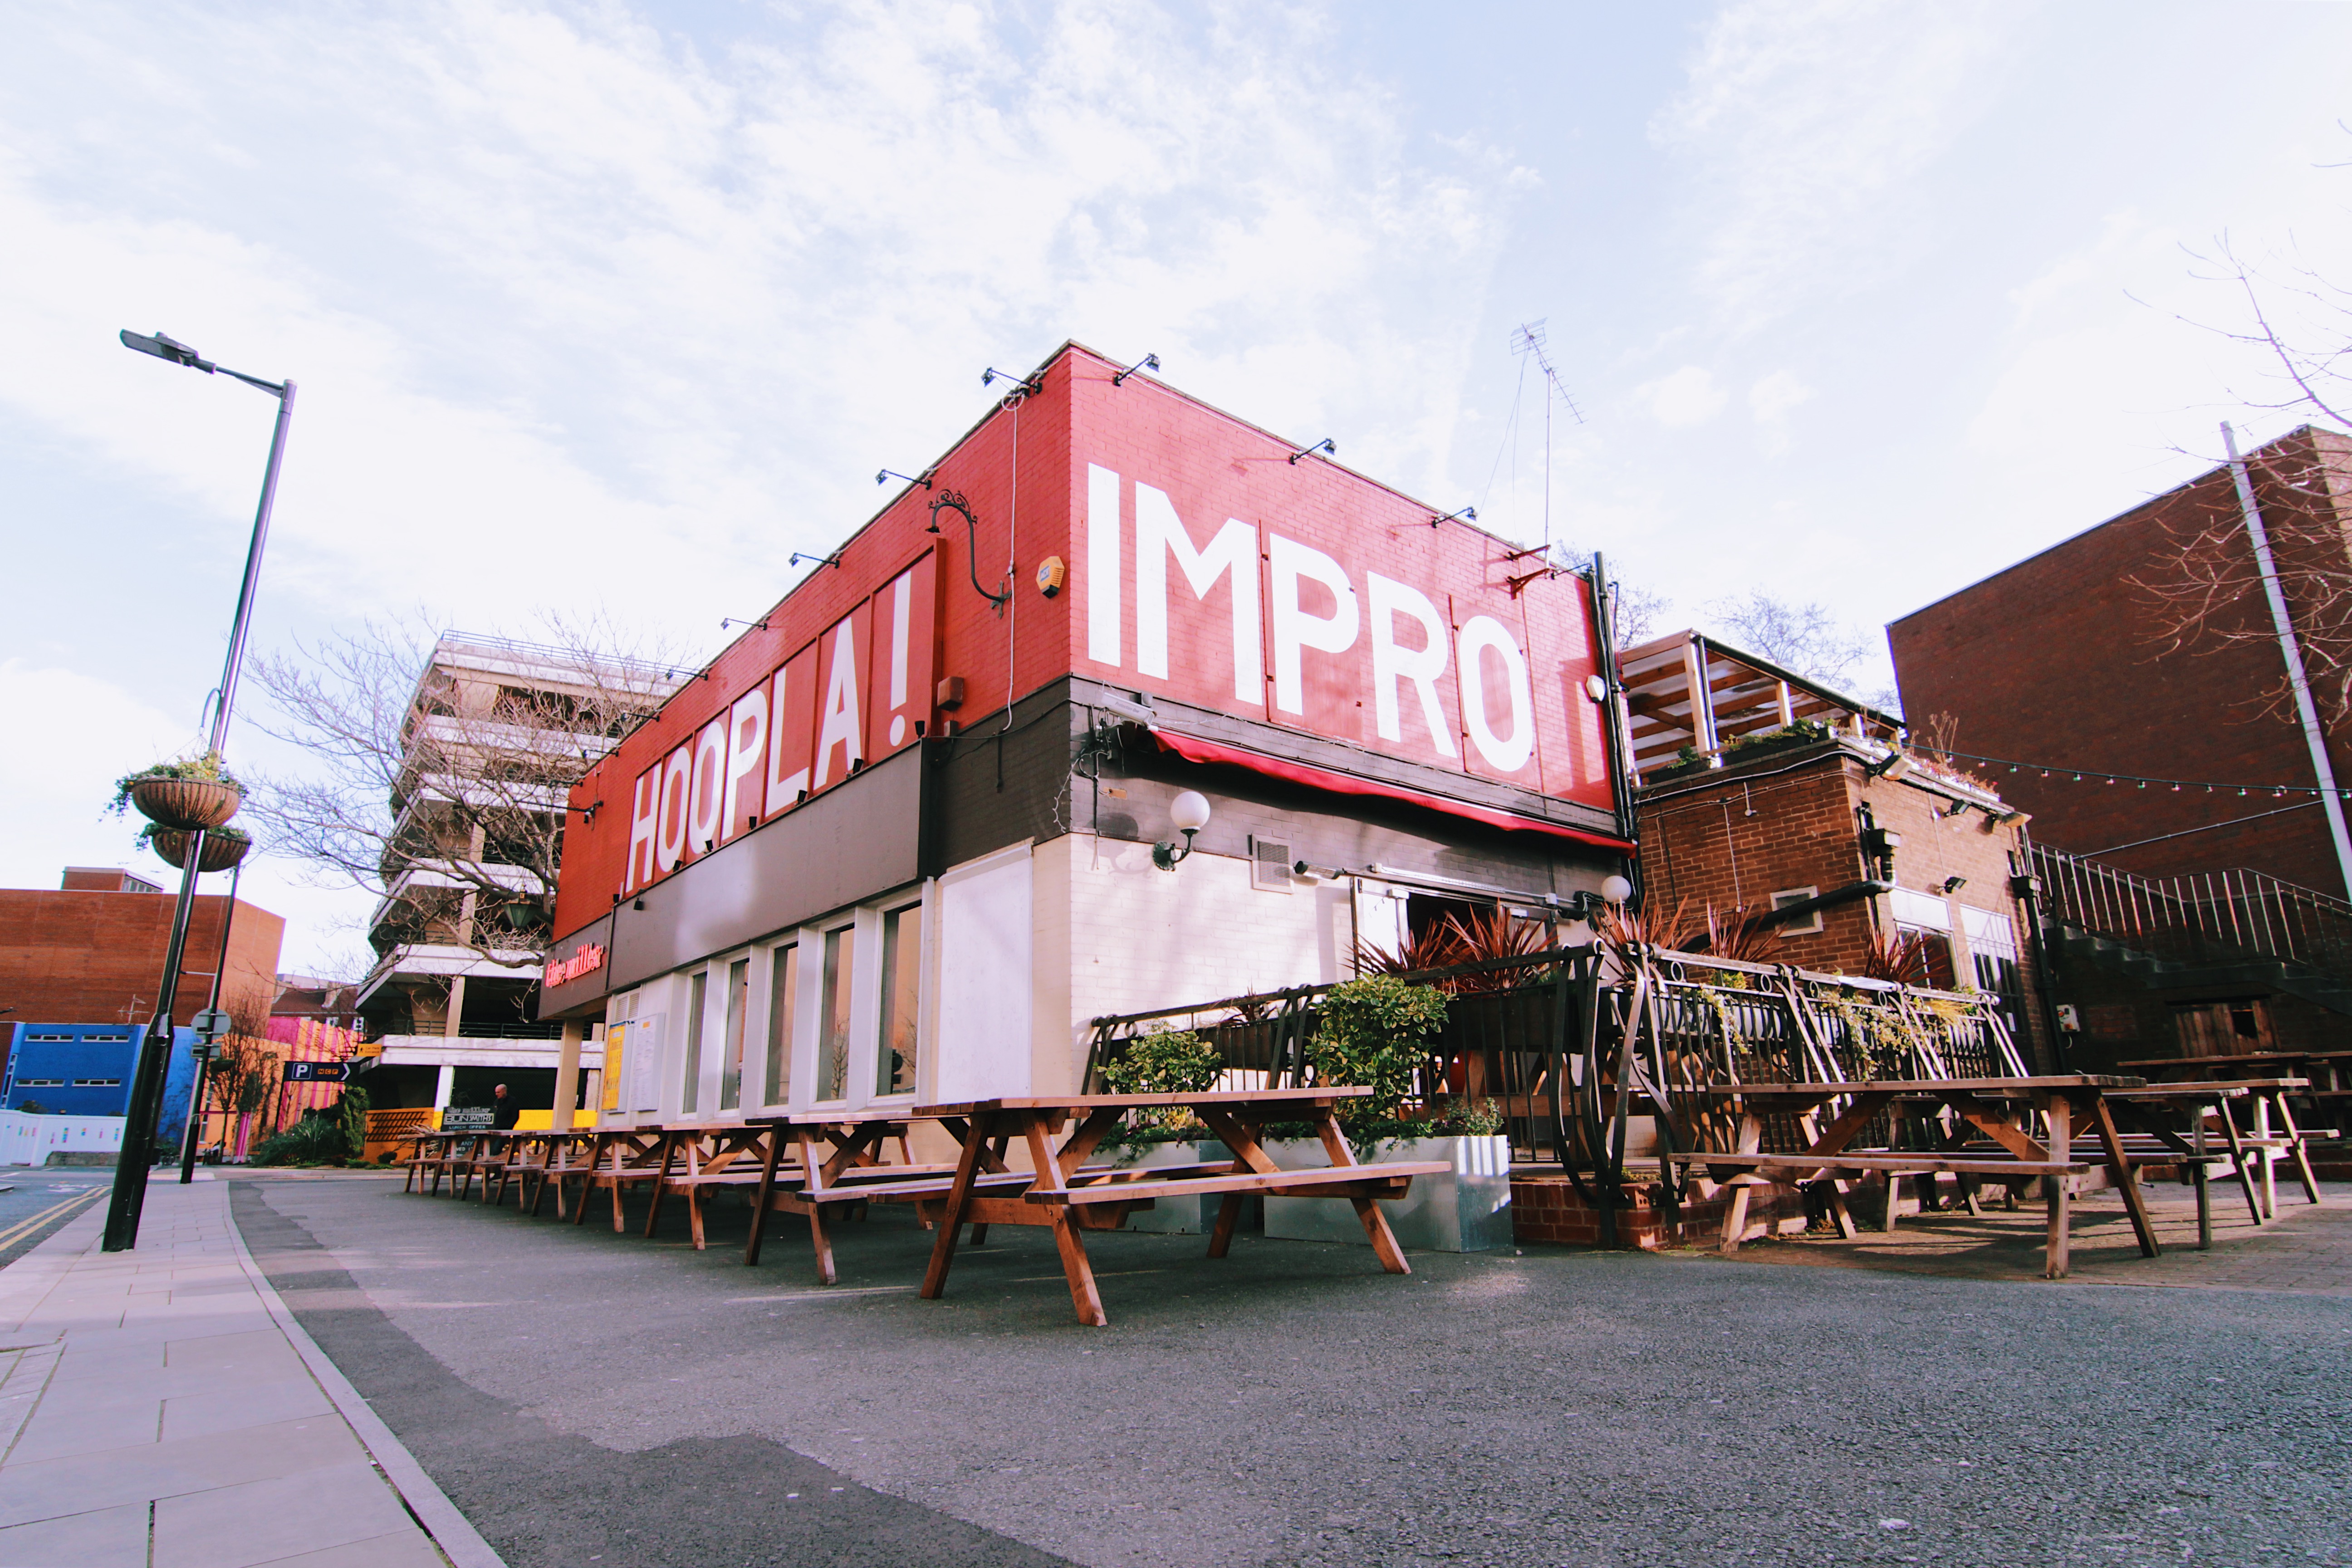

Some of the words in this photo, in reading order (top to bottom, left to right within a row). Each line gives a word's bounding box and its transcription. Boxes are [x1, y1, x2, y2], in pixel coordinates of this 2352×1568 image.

[1088, 462, 1534, 772] IMPRO
[626, 571, 911, 894] HOOPLA!
[545, 958, 566, 988] the
[565, 942, 604, 980] miller
[295, 1064, 308, 1078] P
